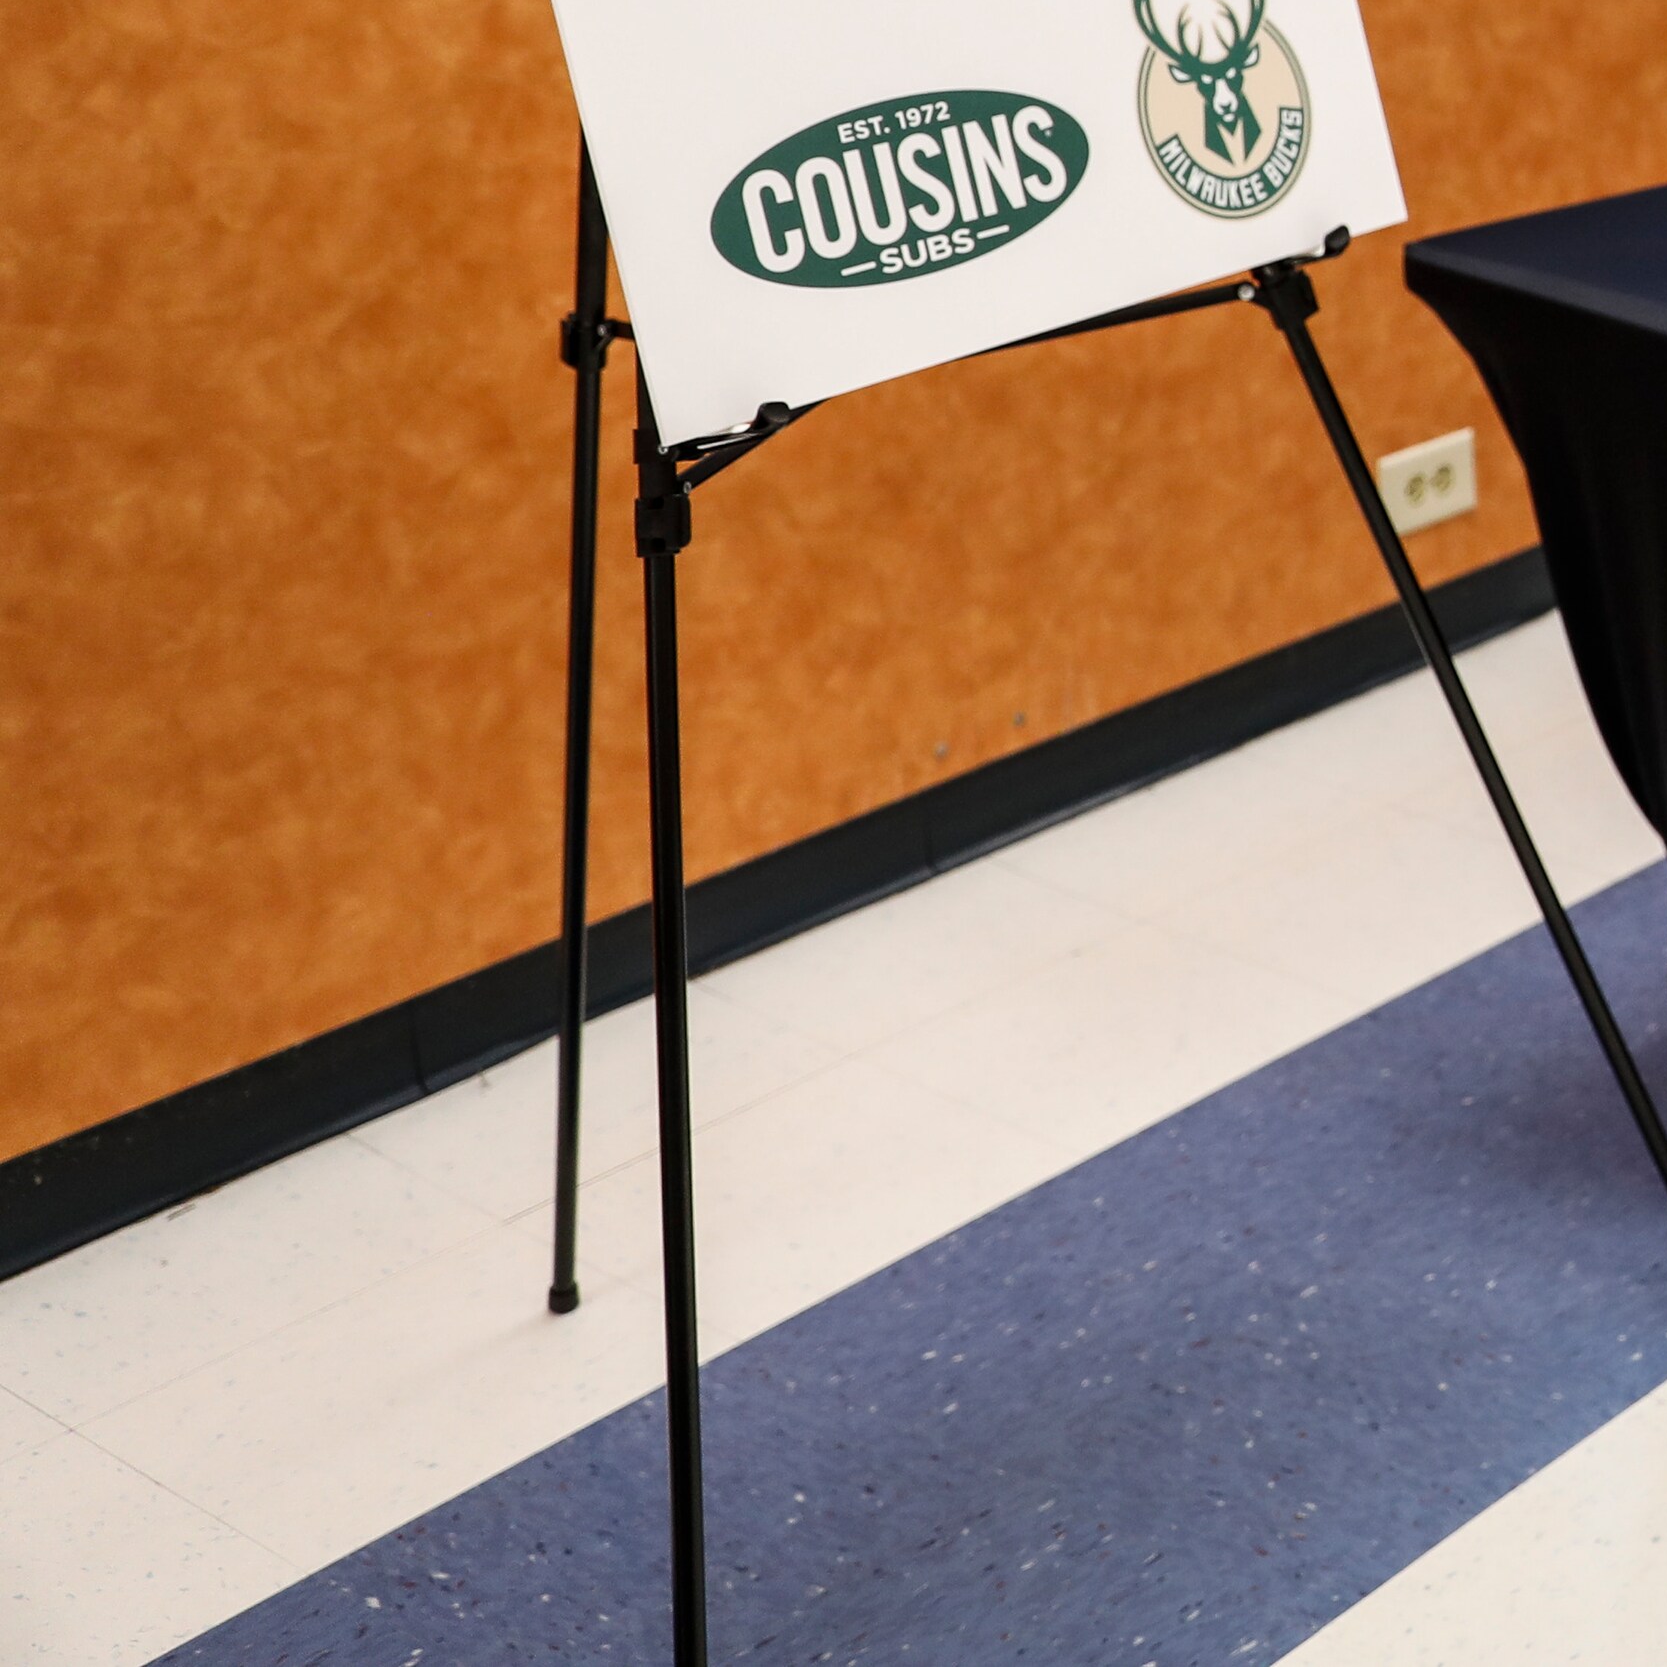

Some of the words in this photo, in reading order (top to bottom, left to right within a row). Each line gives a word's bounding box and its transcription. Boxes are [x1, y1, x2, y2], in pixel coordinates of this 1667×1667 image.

[836, 116, 891, 144] EST.
[894, 100, 951, 130] 1972
[1158, 138, 1268, 208] MILWAUKEE
[1262, 109, 1303, 189] BUCKS
[741, 105, 1068, 274] COUSINS
[878, 227, 976, 274] SUBS
